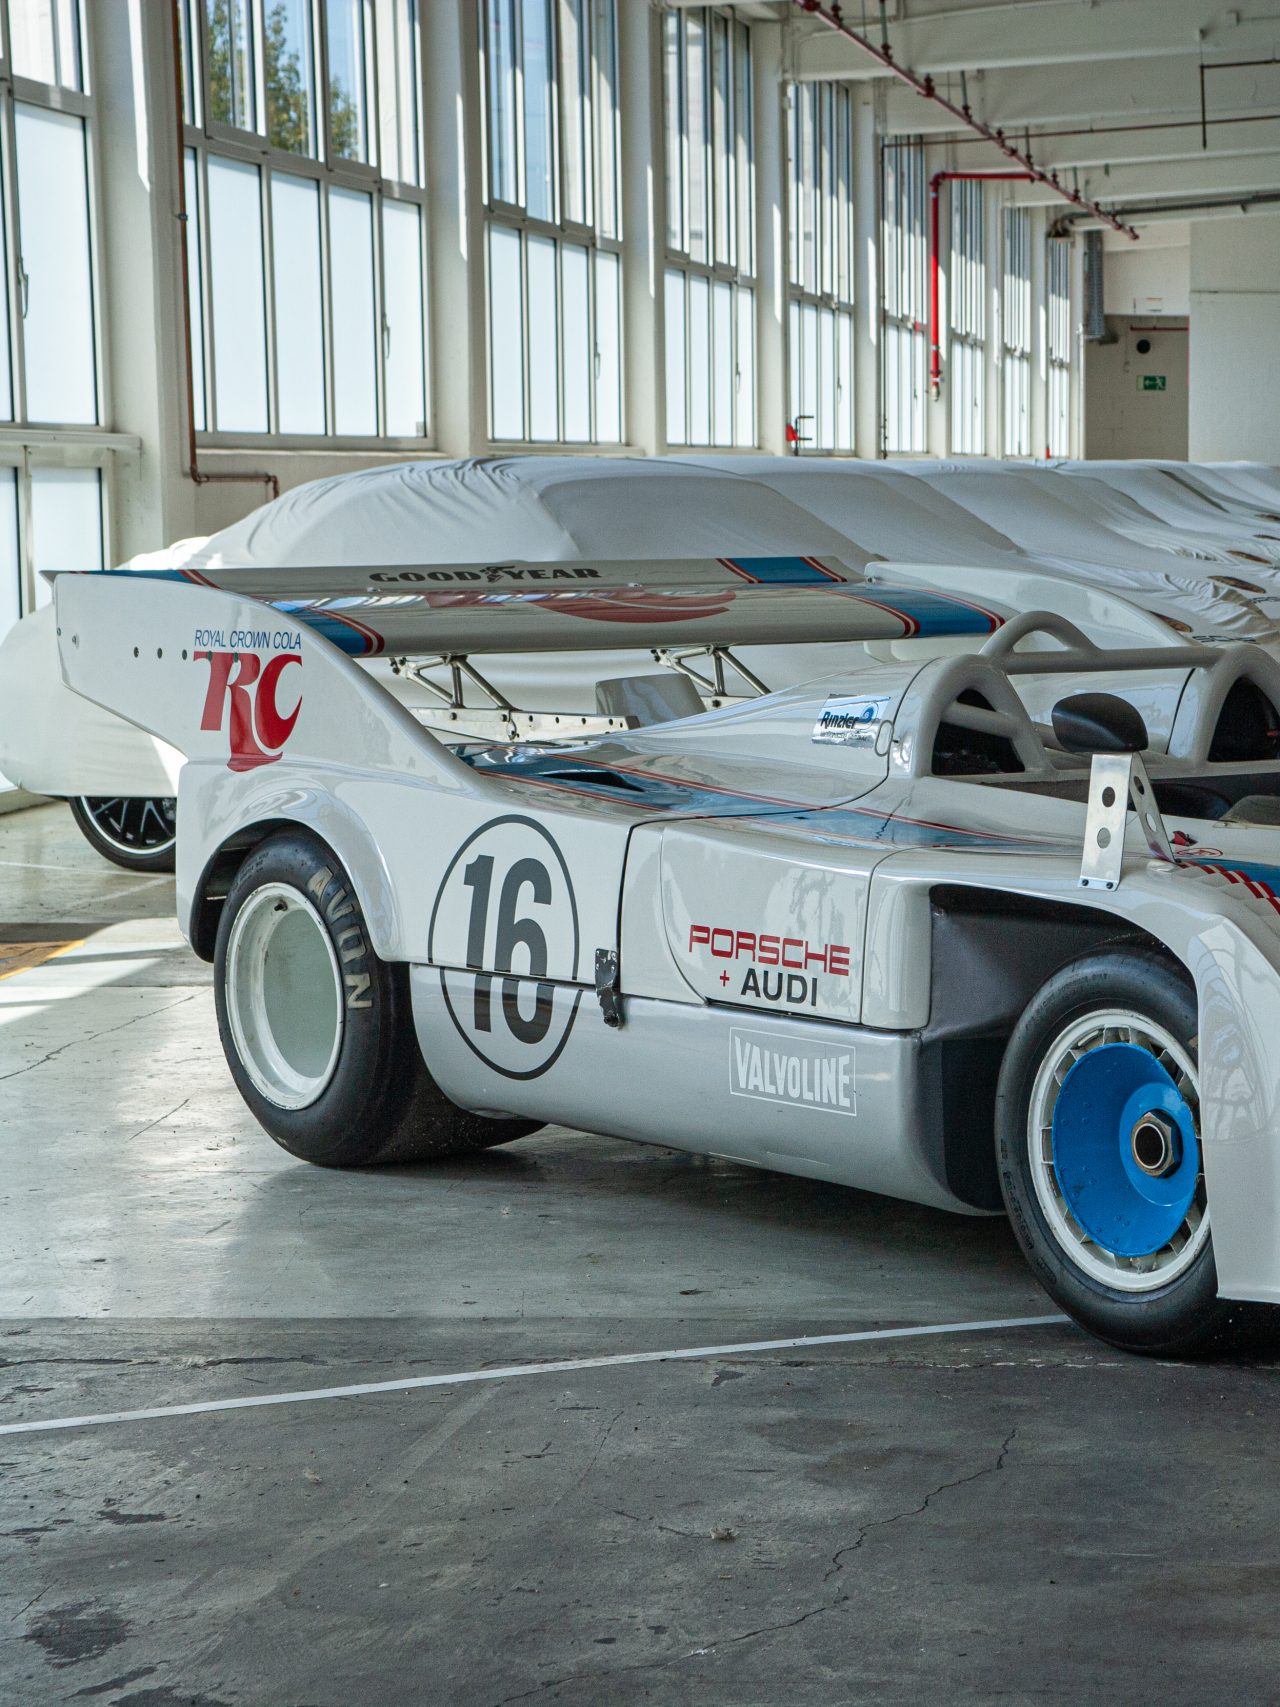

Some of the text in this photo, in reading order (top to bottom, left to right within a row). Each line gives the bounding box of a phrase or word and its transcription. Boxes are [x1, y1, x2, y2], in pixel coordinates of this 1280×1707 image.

[194, 629, 302, 650] ROYAL CROWN COLA
[193, 650, 303, 773] RC
[306, 865, 373, 1009] AVON
[464, 854, 556, 1044] 16
[689, 924, 850, 976] PORSCHE
[740, 967, 818, 1007] AUDI
[734, 1035, 851, 1108] VALVOLINE
